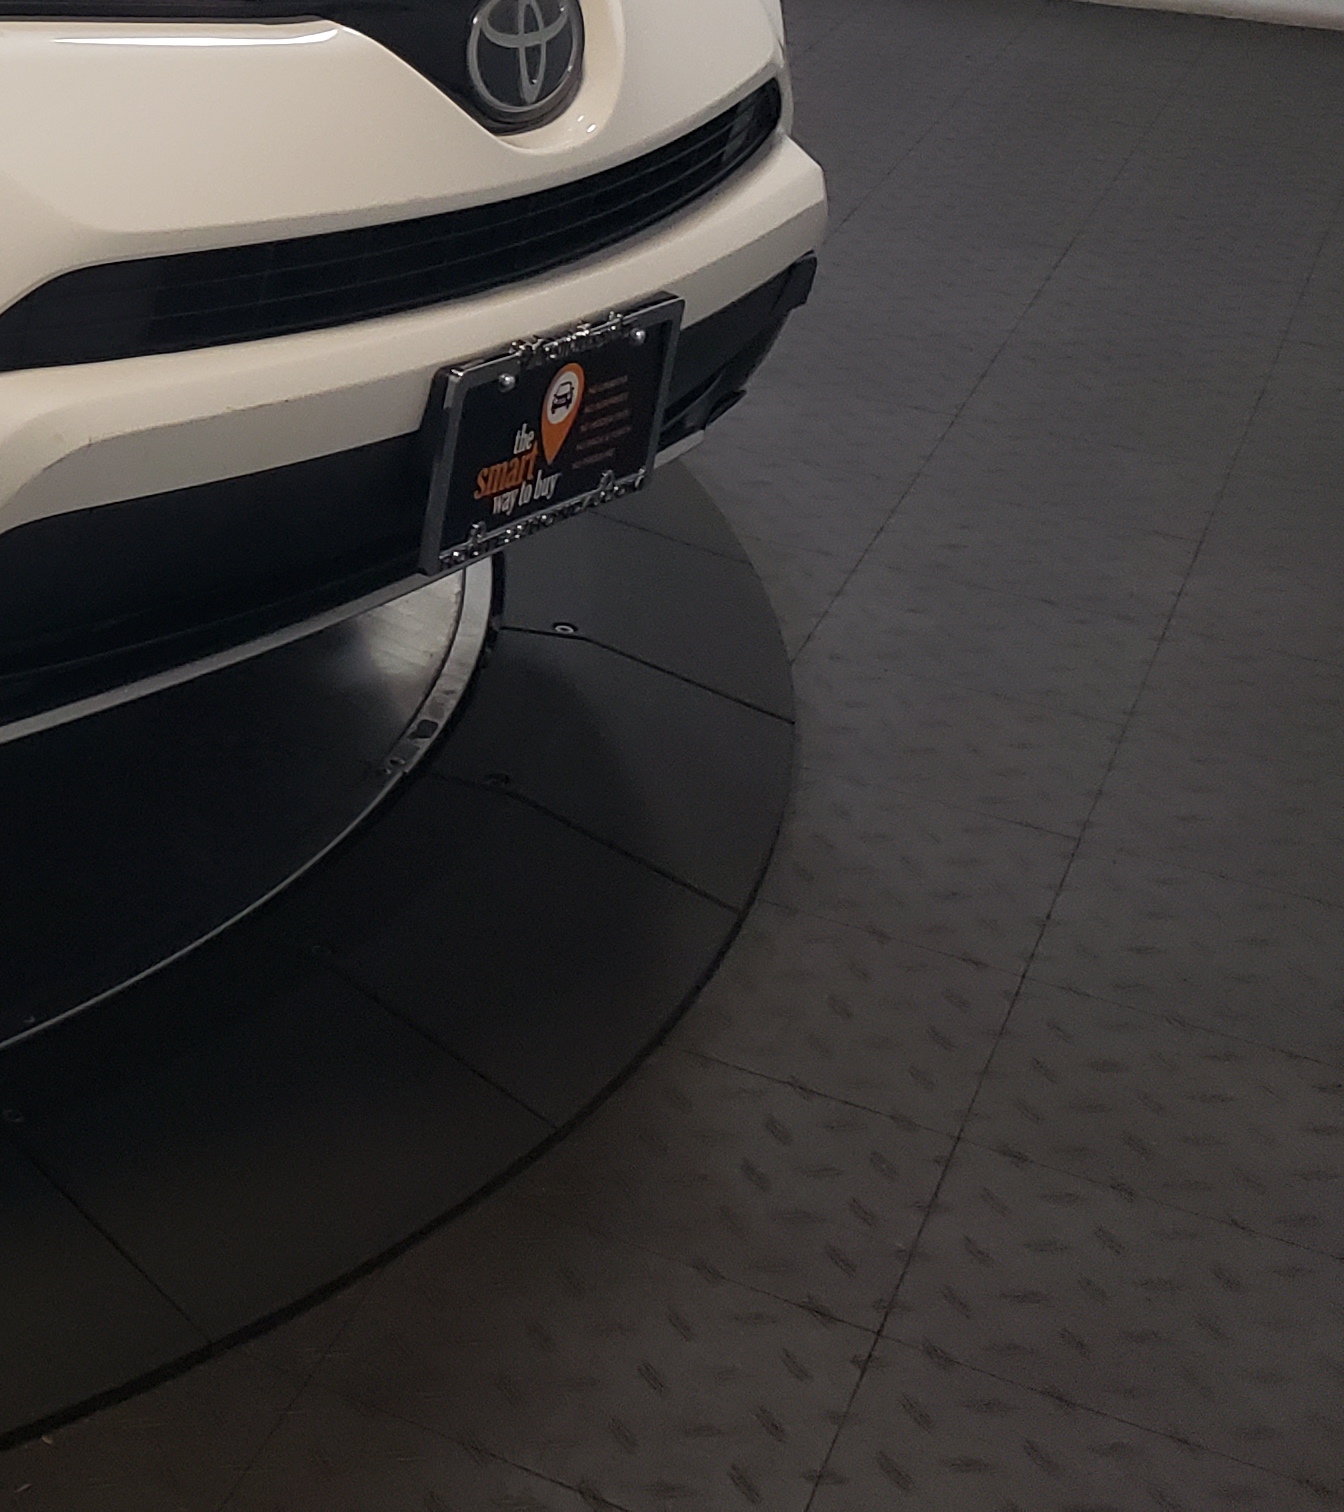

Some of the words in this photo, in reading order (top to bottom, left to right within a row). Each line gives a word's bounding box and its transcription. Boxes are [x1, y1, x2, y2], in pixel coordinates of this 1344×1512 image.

[513, 423, 534, 454] the
[474, 440, 538, 499] smart
[493, 488, 519, 516] way
[518, 481, 532, 506] to
[533, 469, 561, 499] buy
